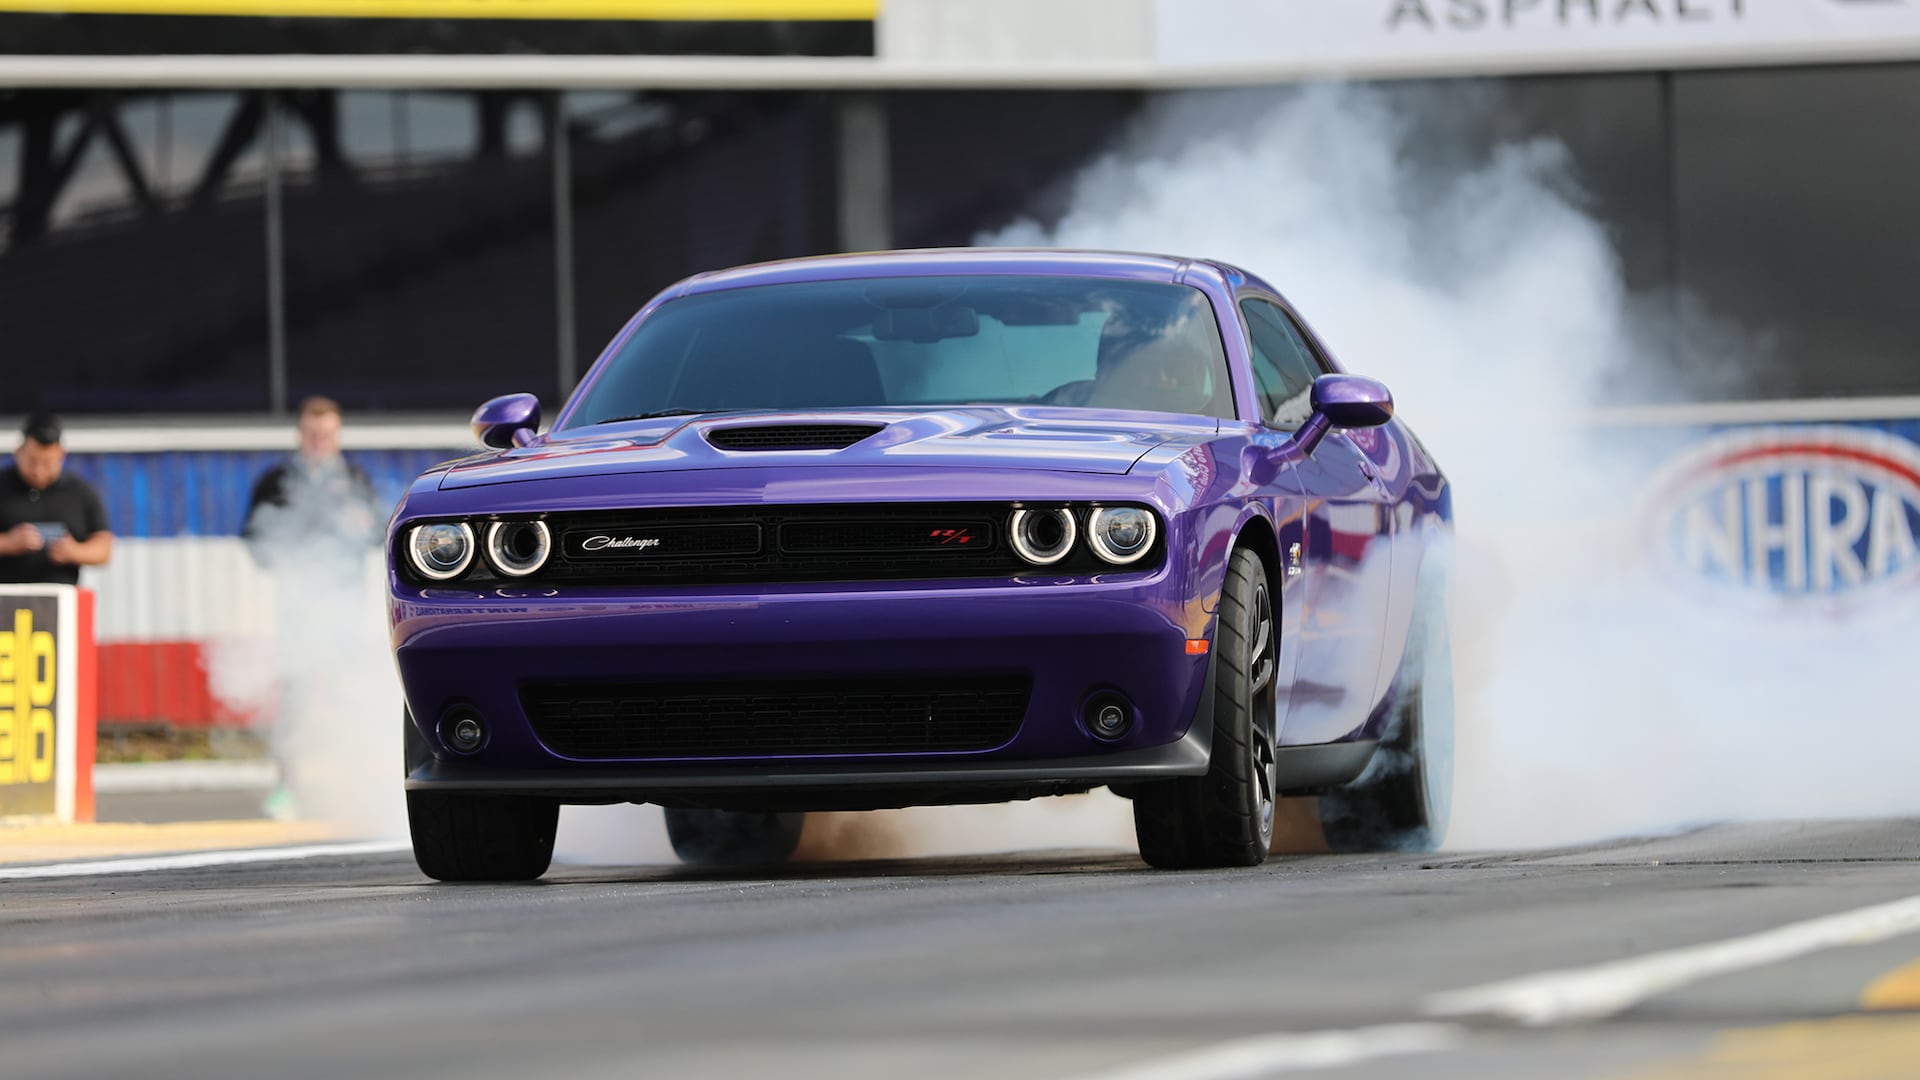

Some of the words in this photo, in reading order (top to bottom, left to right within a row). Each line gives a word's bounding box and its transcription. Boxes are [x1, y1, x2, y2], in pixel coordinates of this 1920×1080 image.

[930, 528, 976, 545] R/T
[1684, 470, 1919, 592] NHRA
[582, 535, 660, 551] Challenger
